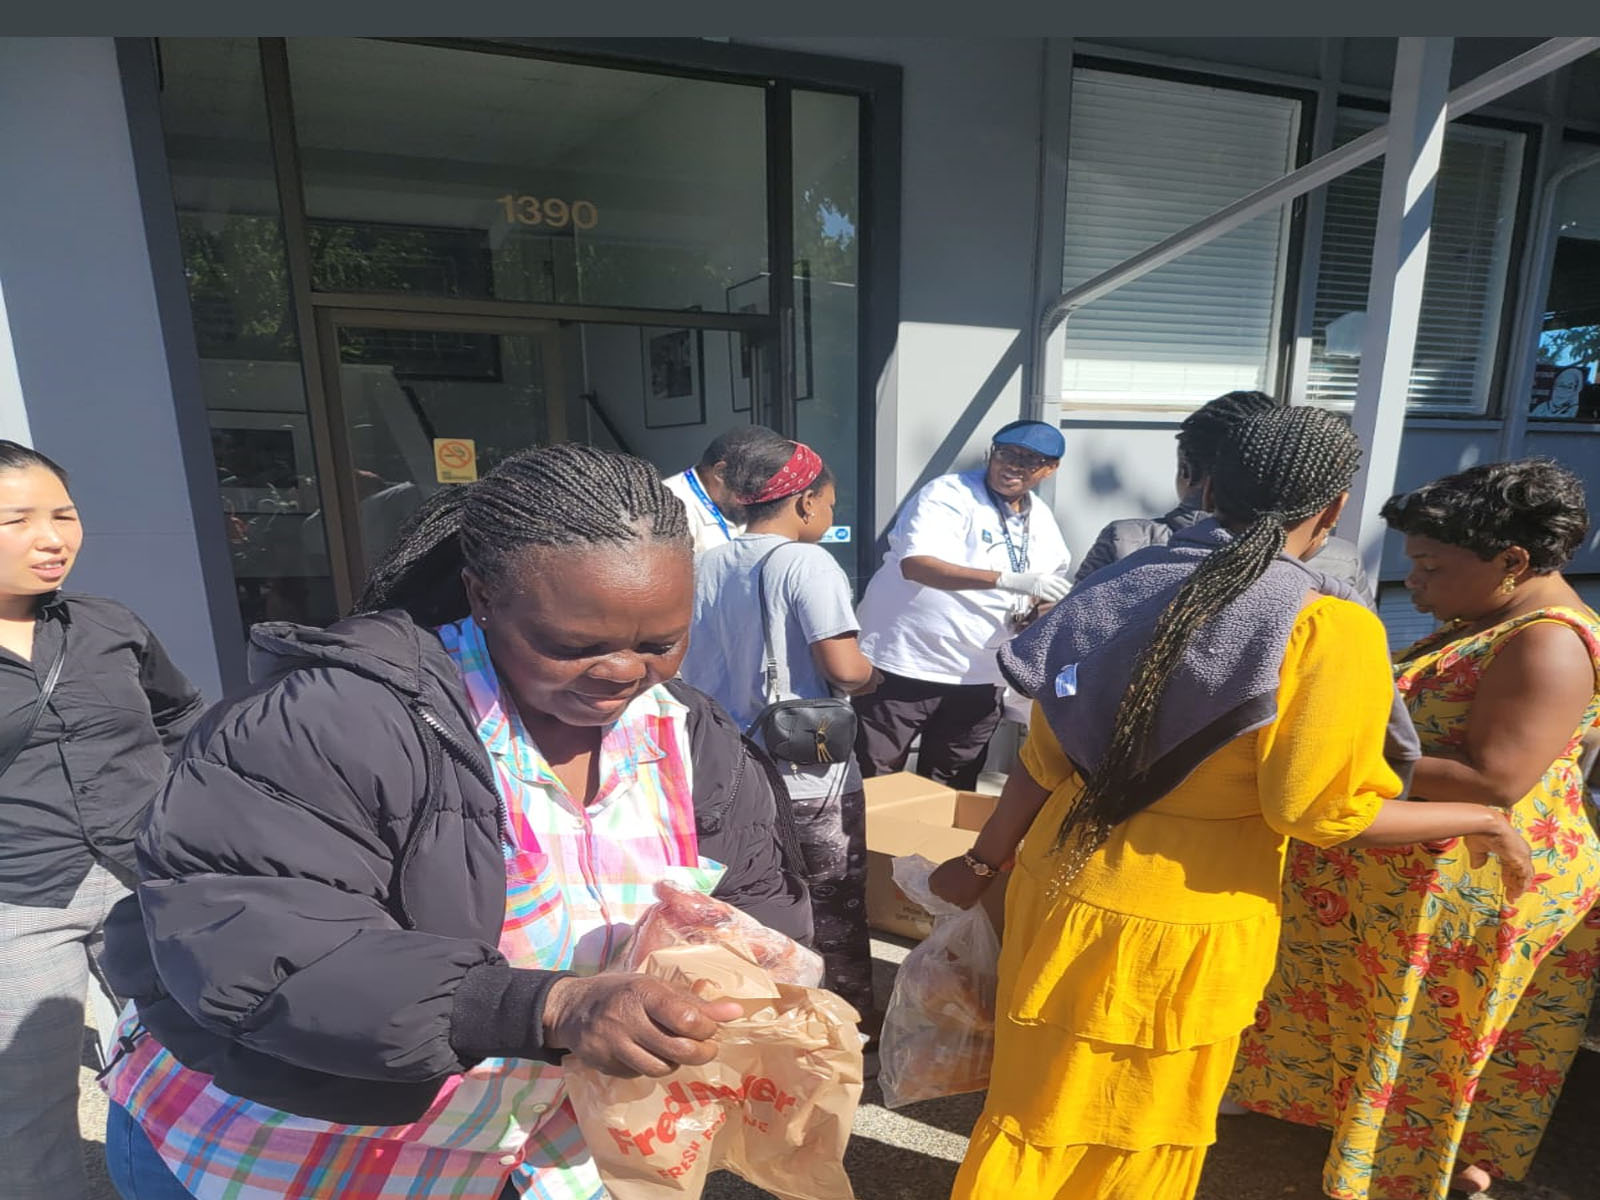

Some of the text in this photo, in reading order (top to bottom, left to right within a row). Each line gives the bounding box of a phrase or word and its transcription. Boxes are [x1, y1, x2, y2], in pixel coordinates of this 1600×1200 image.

[496, 194, 598, 229] 1390
[608, 1080, 695, 1157] Fred
[656, 1140, 700, 1179] FRESH
